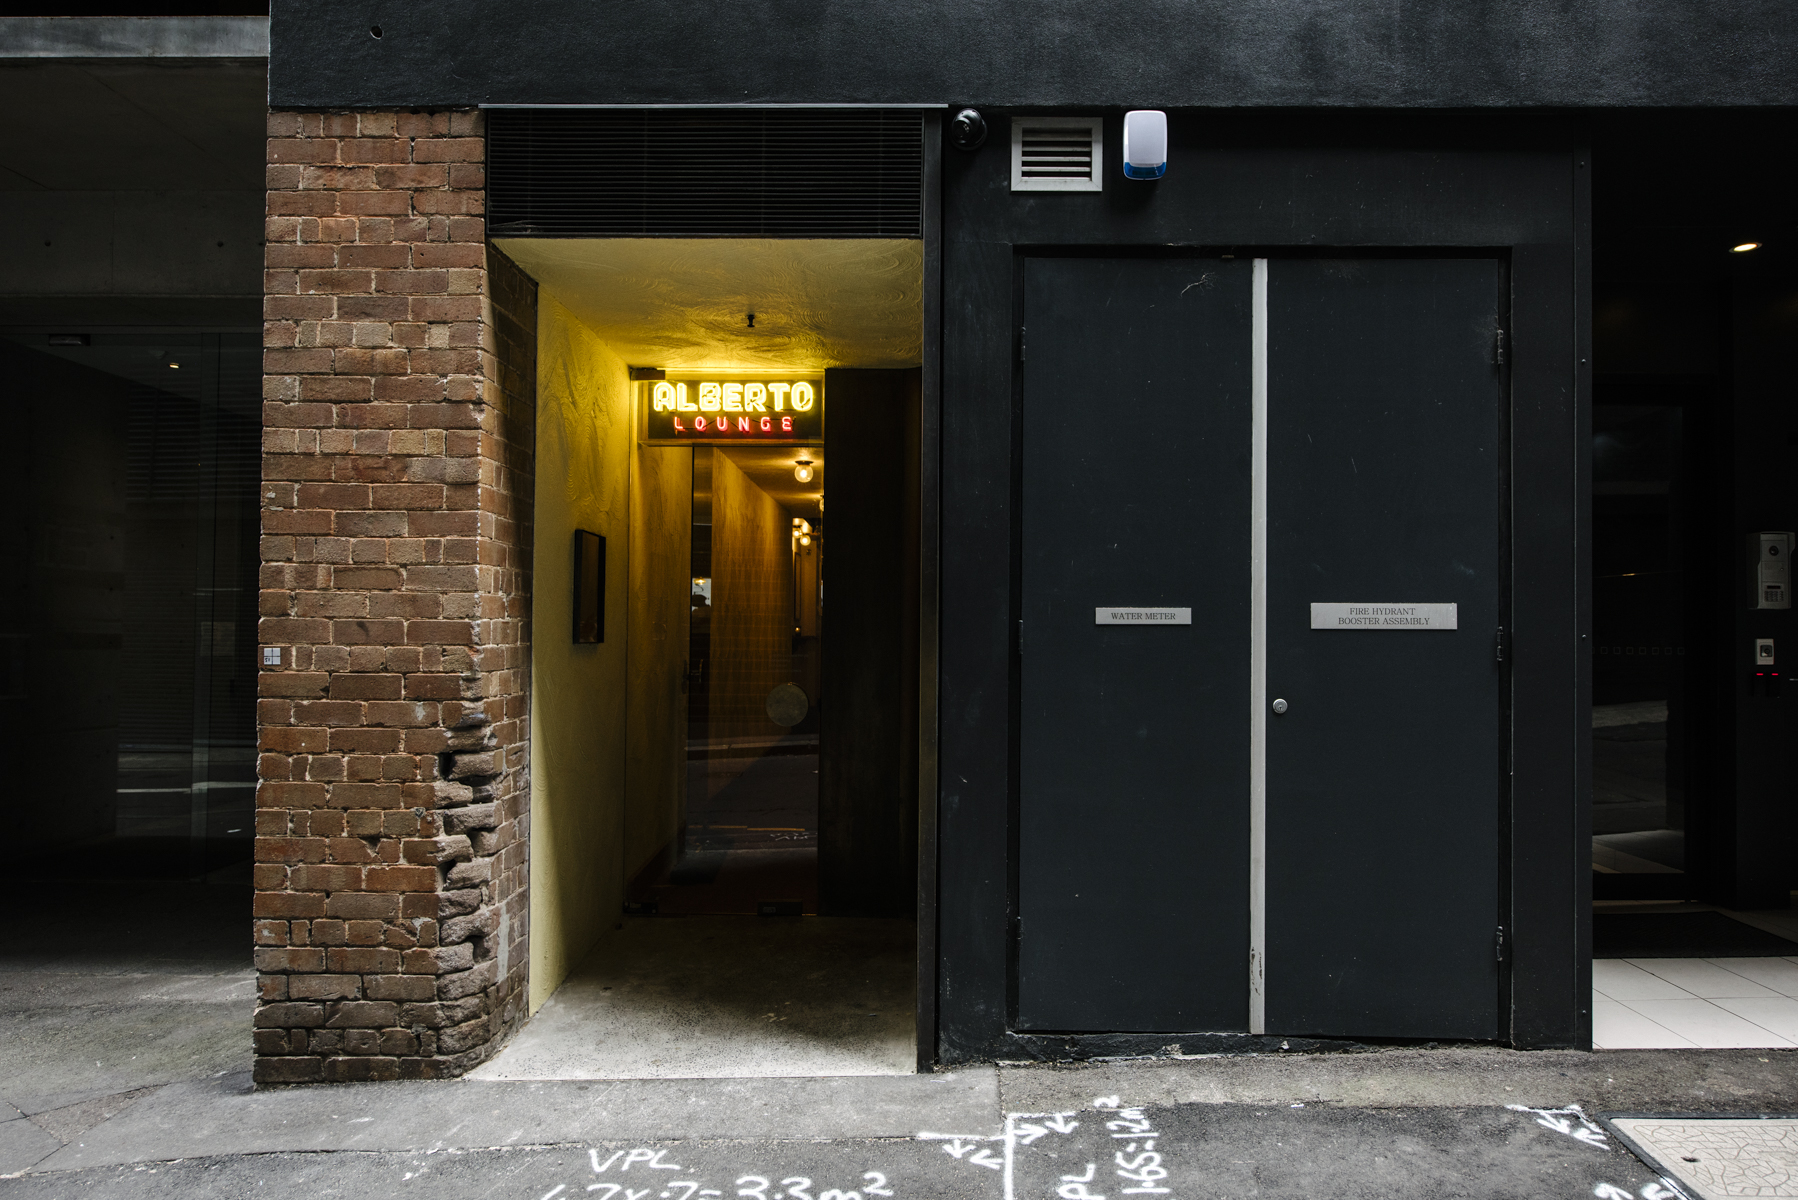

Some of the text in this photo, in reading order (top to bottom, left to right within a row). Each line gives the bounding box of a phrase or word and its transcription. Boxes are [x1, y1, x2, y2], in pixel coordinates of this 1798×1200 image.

[653, 381, 814, 412] ALBERTO
[674, 416, 793, 432] LOUNGE
[1111, 612, 1176, 620] WATER METER
[1338, 617, 1430, 625] BOOSTER ASSEMBLY
[587, 1147, 681, 1173] VPL
